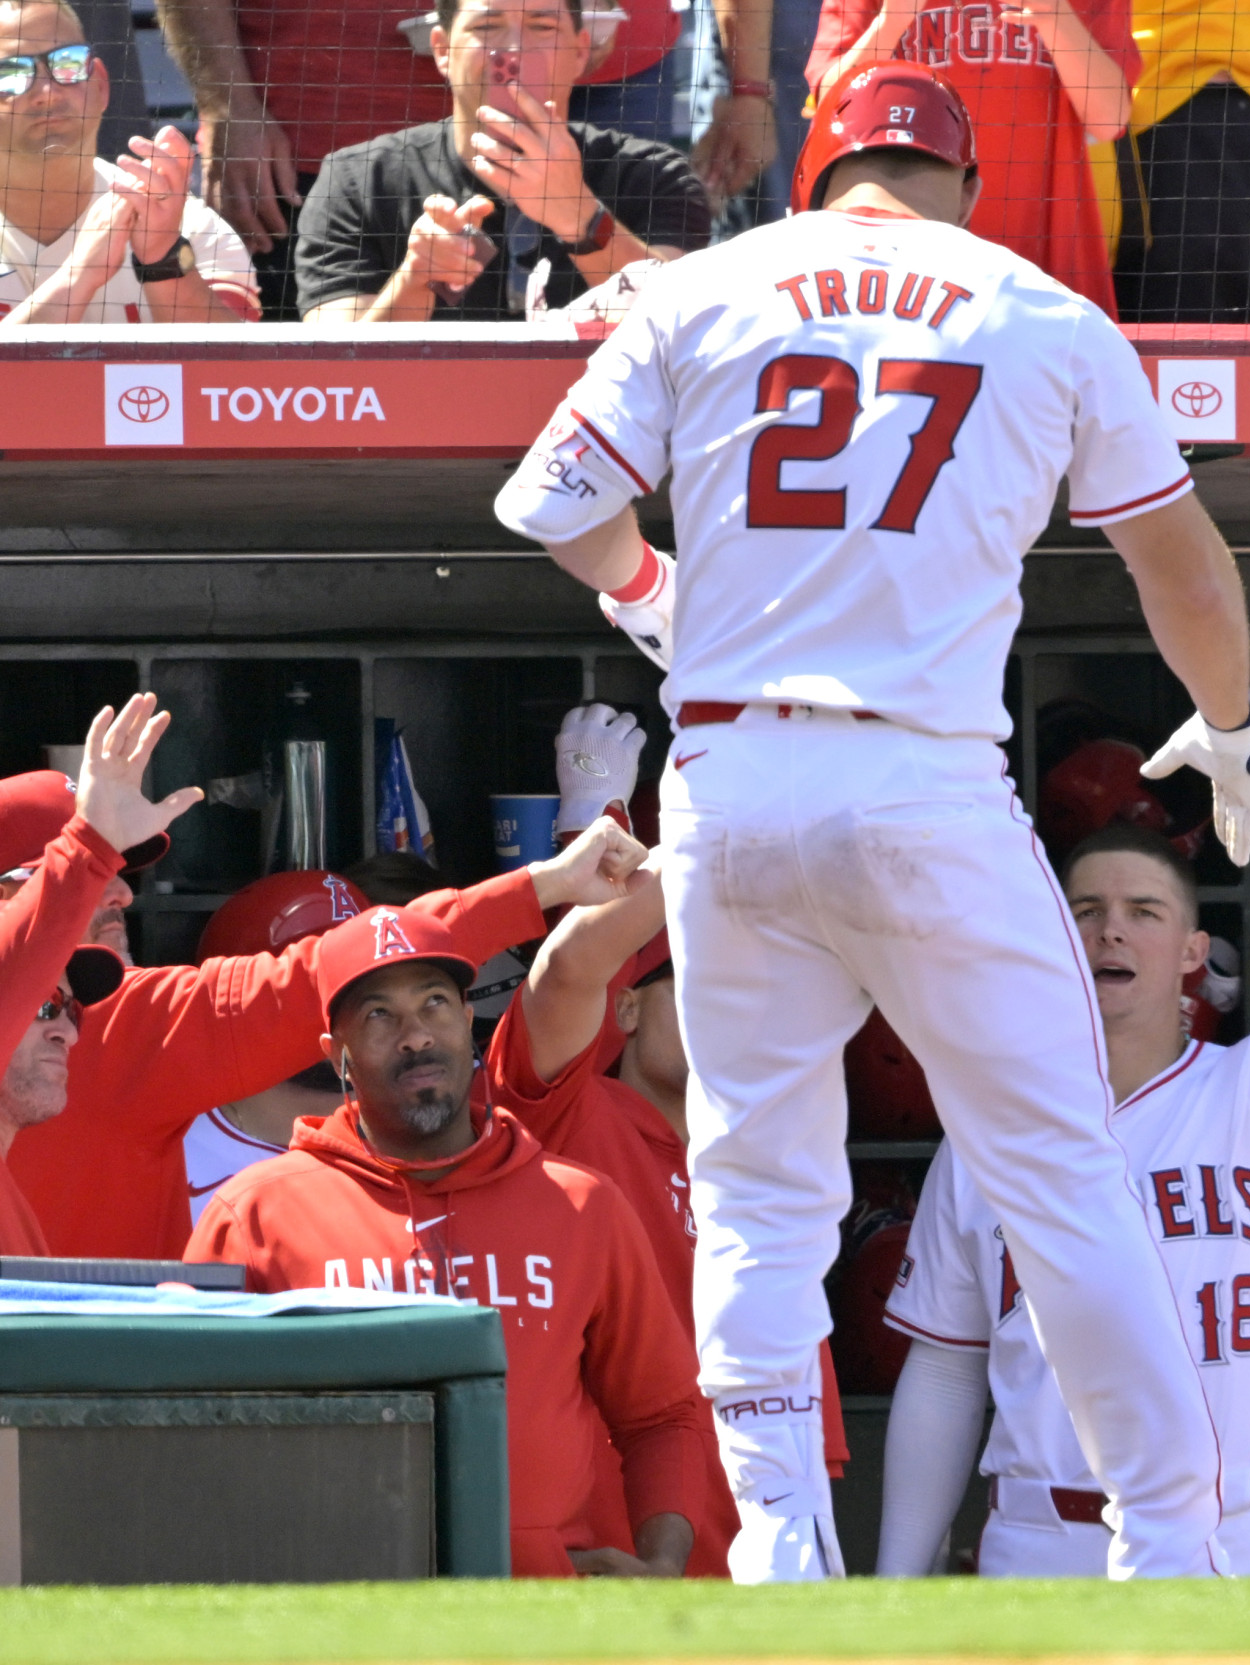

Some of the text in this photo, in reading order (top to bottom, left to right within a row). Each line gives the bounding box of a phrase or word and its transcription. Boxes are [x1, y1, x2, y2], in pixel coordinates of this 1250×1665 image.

[889, 106, 916, 123] 27
[775, 268, 975, 330] TROUT
[201, 386, 386, 422] TOYOTA
[746, 353, 985, 535] 27
[324, 1254, 554, 1309] ANGELS
